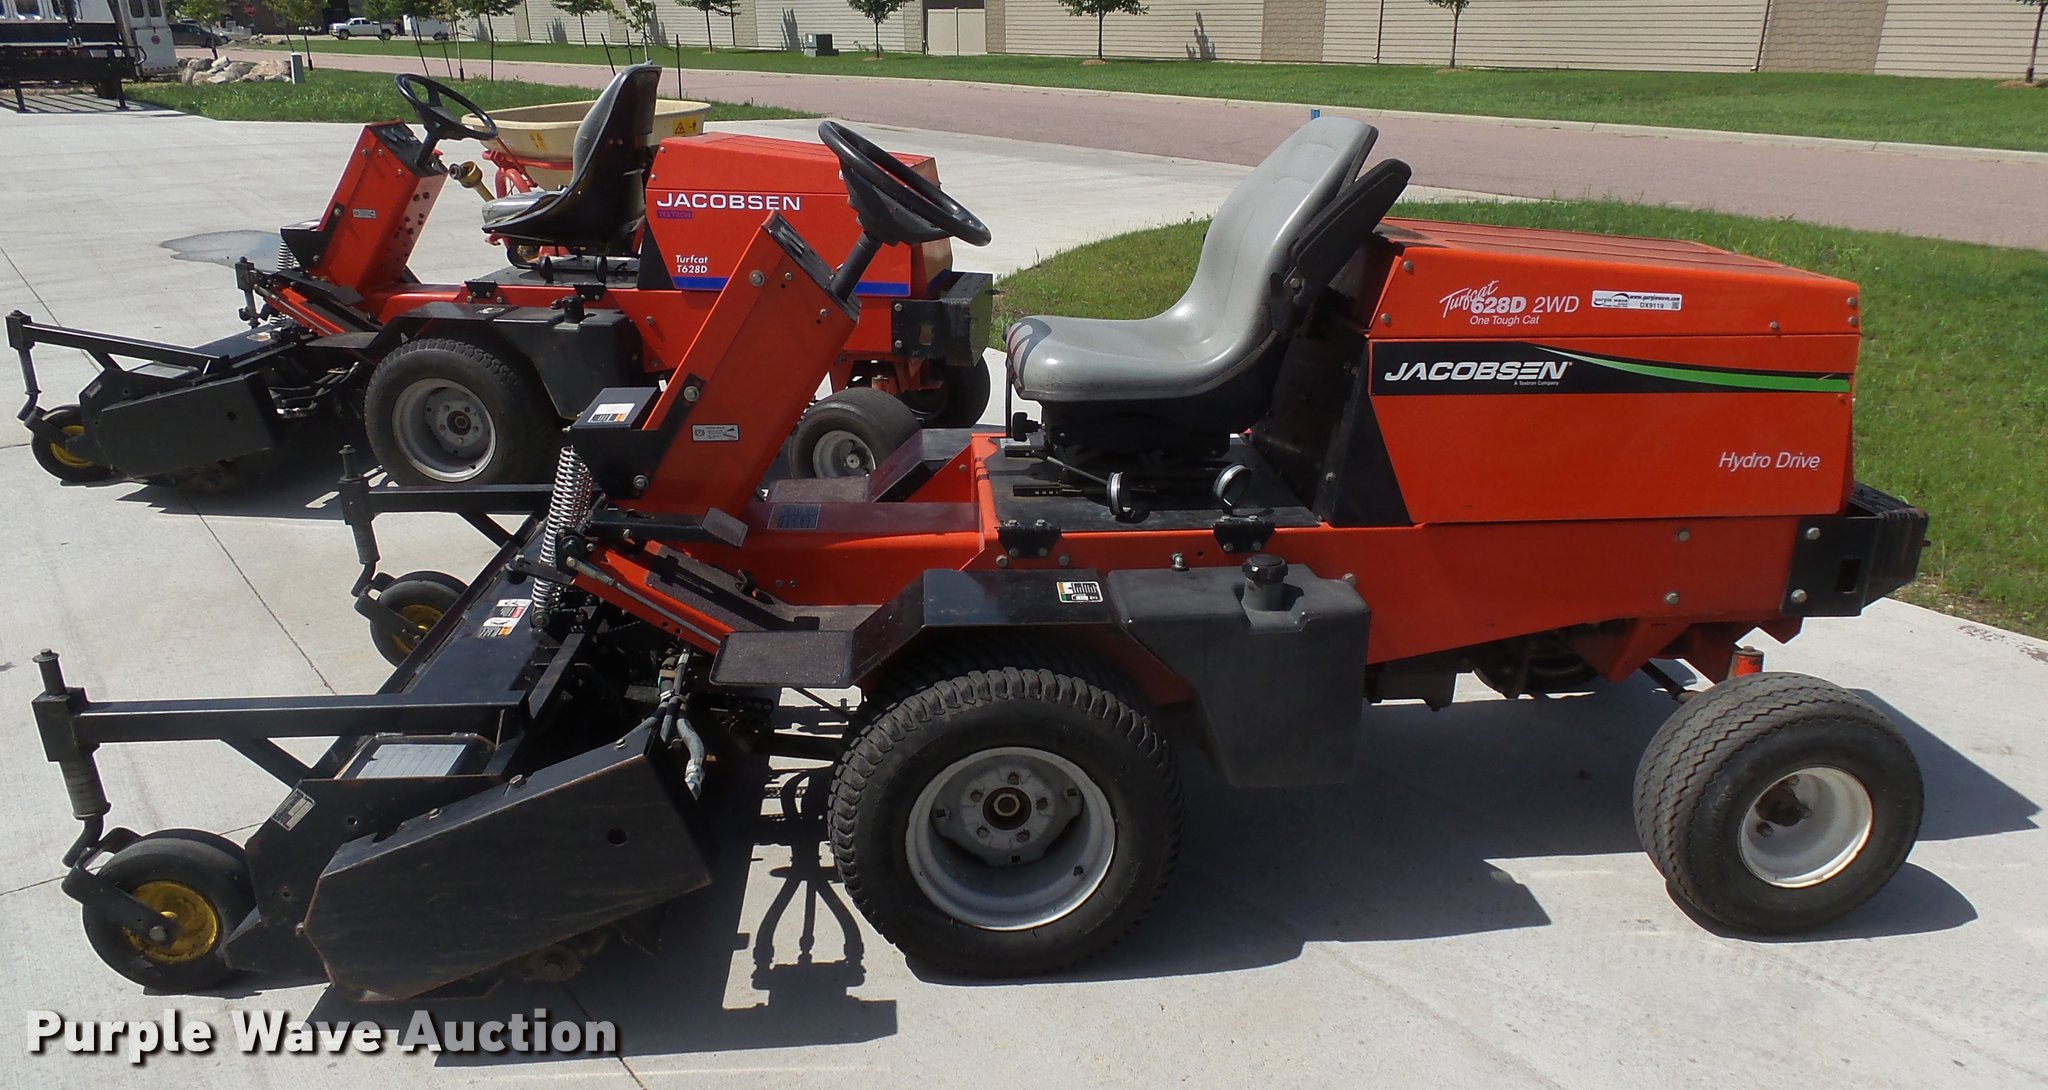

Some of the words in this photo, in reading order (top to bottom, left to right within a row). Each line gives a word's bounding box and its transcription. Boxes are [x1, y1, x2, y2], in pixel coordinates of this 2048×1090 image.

[656, 192, 800, 211] JACOBSEN
[675, 254, 708, 264] Turfcat
[677, 264, 708, 274] T628D
[1440, 280, 1499, 318] Turfcat
[1470, 296, 1527, 314] 628D
[1532, 296, 1580, 313] 2WD
[1470, 315, 1490, 325] One
[1492, 315, 1520, 327] Tough
[1522, 315, 1540, 325] Cat
[1384, 361, 1569, 381] JACOBSEN
[1719, 451, 1772, 472] Hydro
[1775, 452, 1821, 468] Drive
